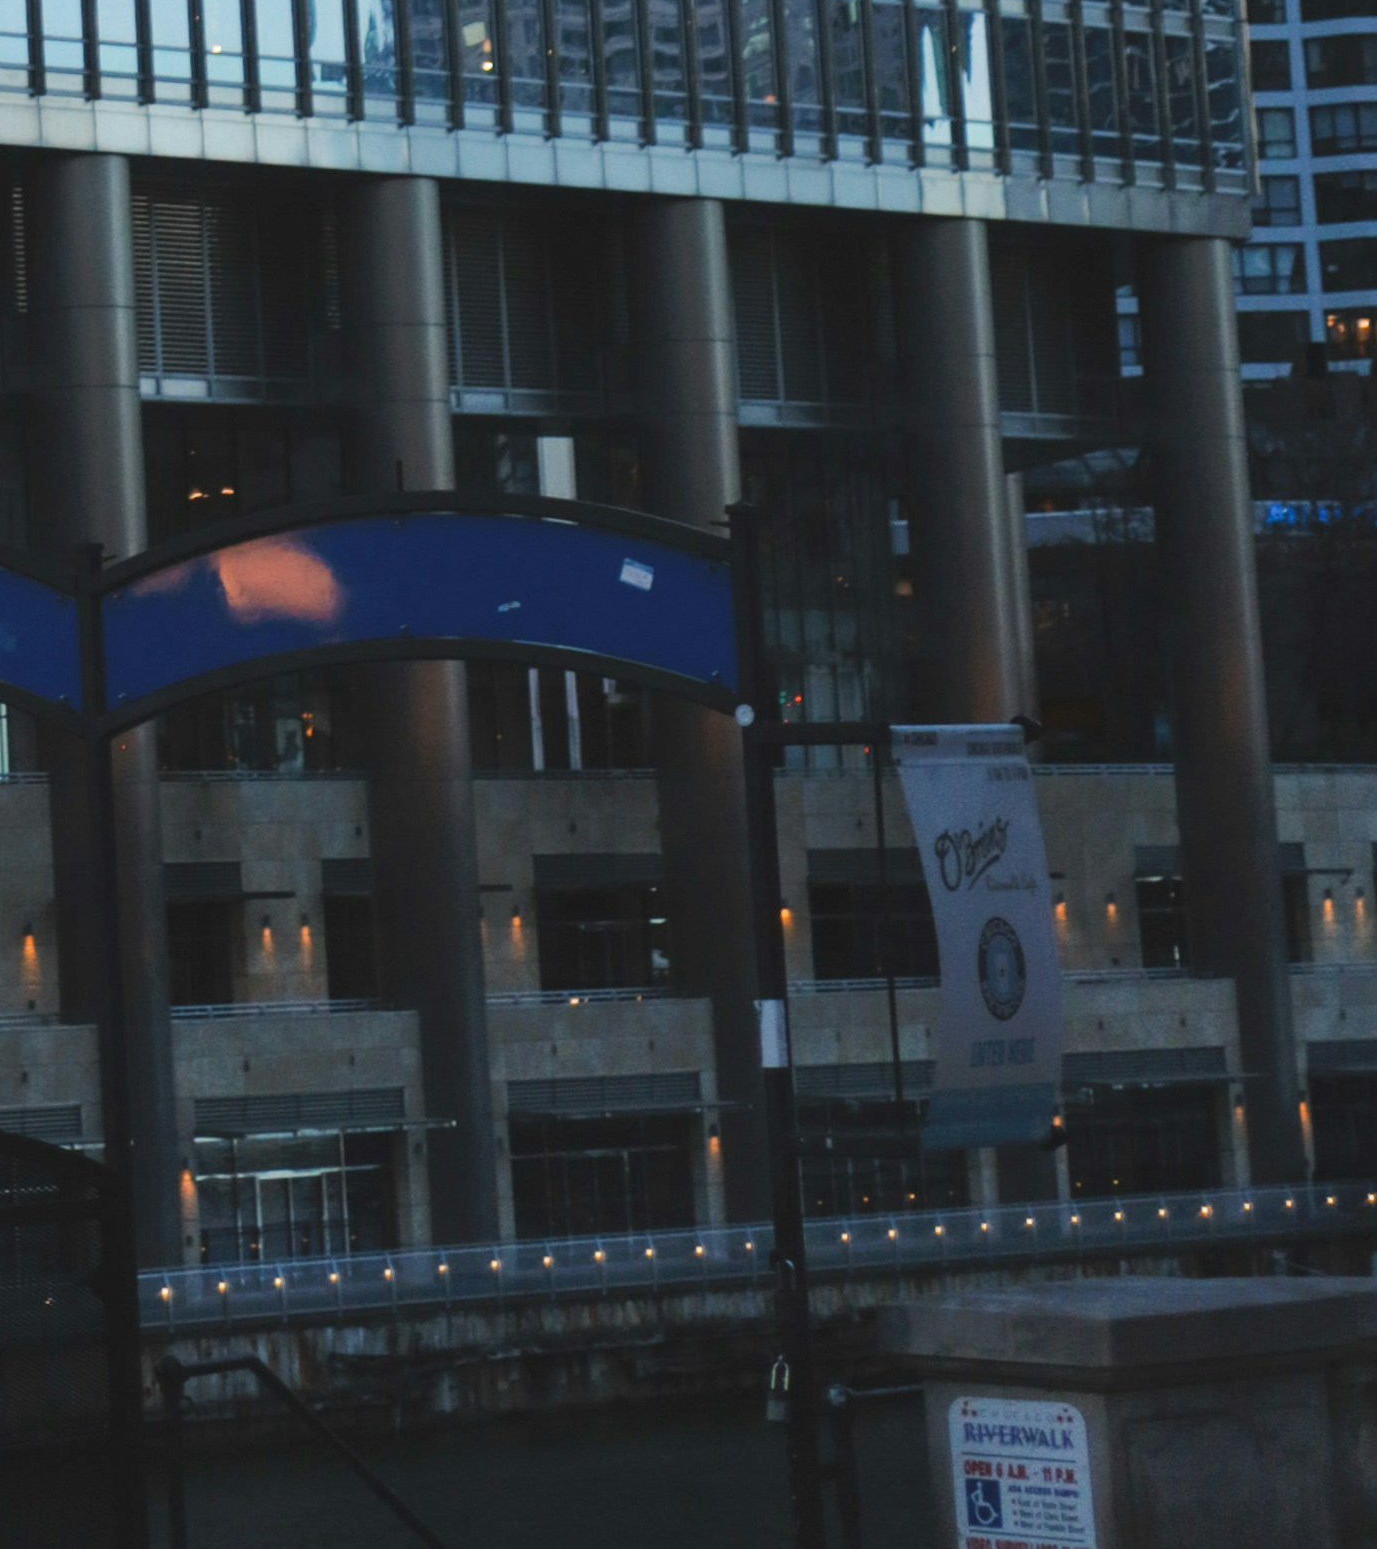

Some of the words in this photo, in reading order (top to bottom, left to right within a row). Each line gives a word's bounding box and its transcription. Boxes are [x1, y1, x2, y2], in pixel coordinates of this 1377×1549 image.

[963, 1422, 1074, 1449] RIVERWALK
[963, 1459, 992, 1477] OPEN
[1008, 1463, 1029, 1480] A.M.
[1055, 1467, 1077, 1484] P.M.
